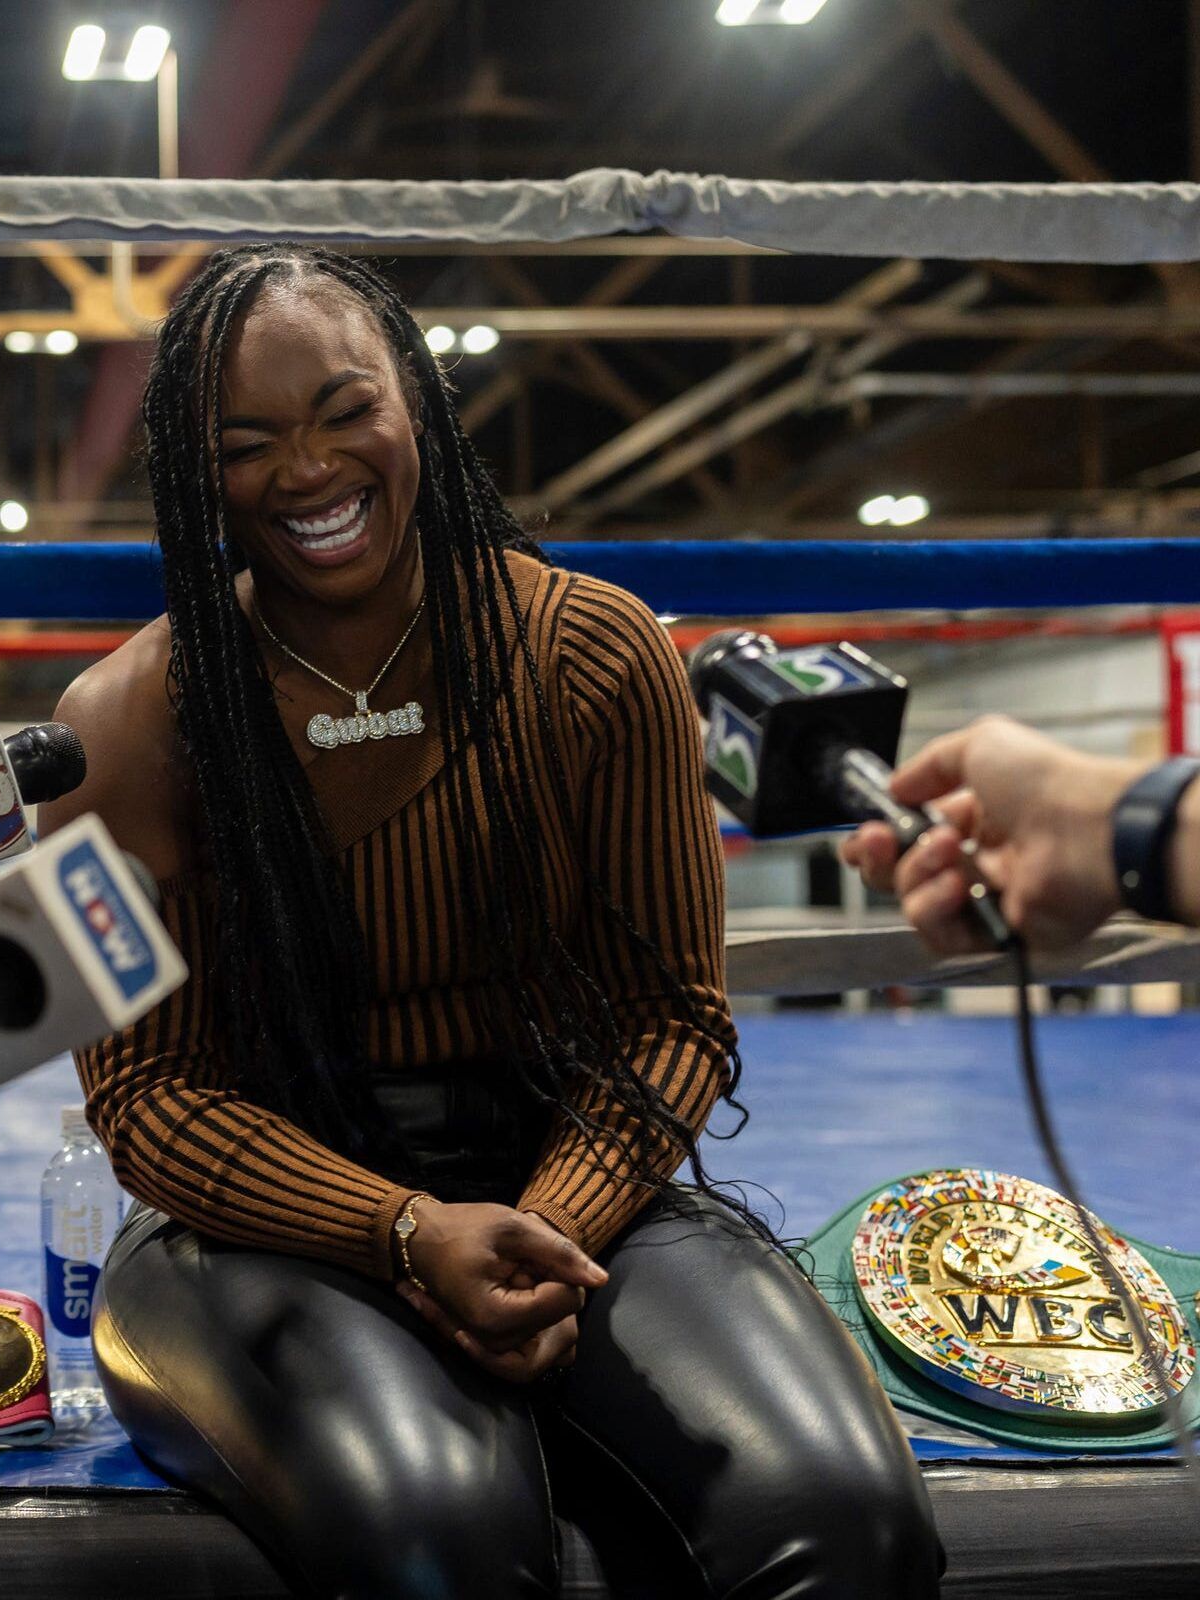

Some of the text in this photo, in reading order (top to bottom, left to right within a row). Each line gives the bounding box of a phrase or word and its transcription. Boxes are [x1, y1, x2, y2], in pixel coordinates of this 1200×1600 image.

[61, 1202, 89, 1320] smart
[86, 1206, 103, 1255] water
[909, 1211, 954, 1286] WORLD
[939, 1294, 1134, 1348] WBC
